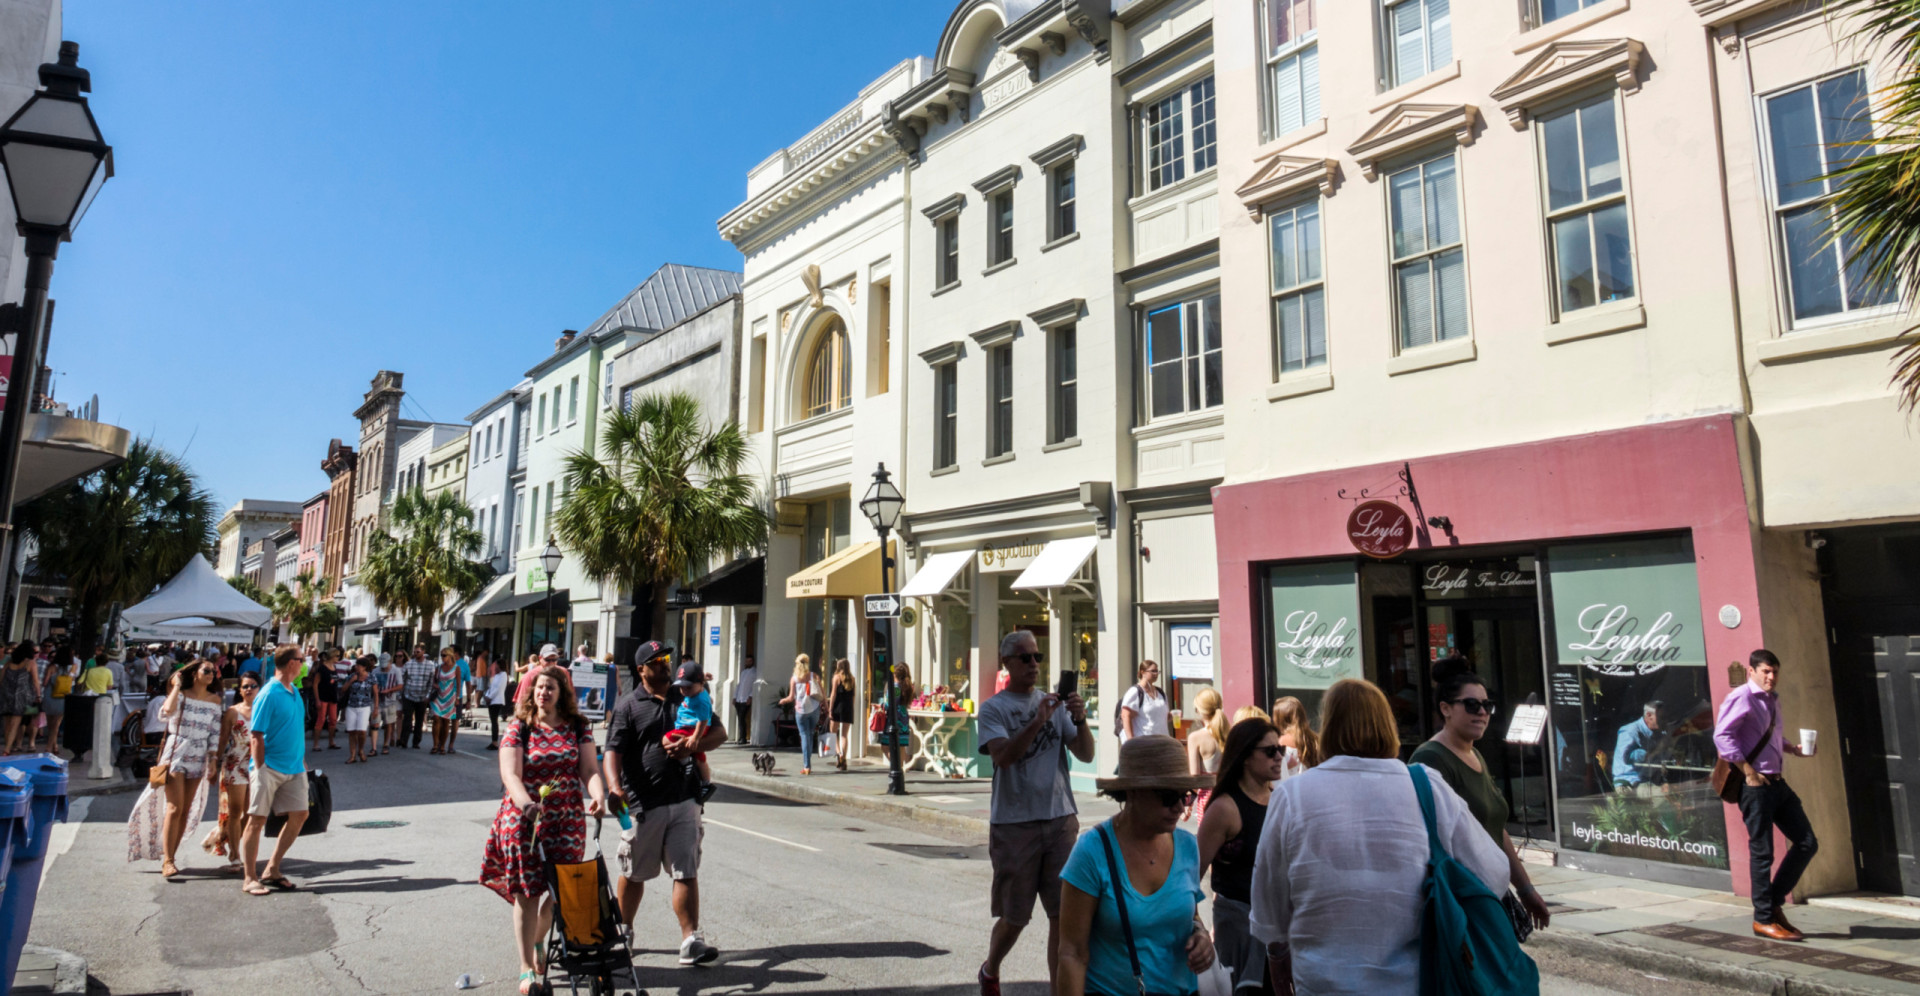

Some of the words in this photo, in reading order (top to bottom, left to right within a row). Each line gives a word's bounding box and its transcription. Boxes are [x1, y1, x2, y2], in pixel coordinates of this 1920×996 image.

[1351, 508, 1405, 545] Leyla
[791, 580, 804, 588] SALON
[804, 578, 823, 586] COUTURE
[1421, 565, 1469, 596] Leyla
[1475, 572, 1498, 588] Fine
[1498, 571, 1536, 586] Lebanese
[868, 602, 879, 611] ONE
[880, 601, 890, 610] WAY
[1177, 634, 1211, 656] PCG
[1278, 610, 1347, 659] Leyla
[1568, 603, 1672, 664] Leyla
[1572, 821, 1717, 856] leyla-charleston.com
